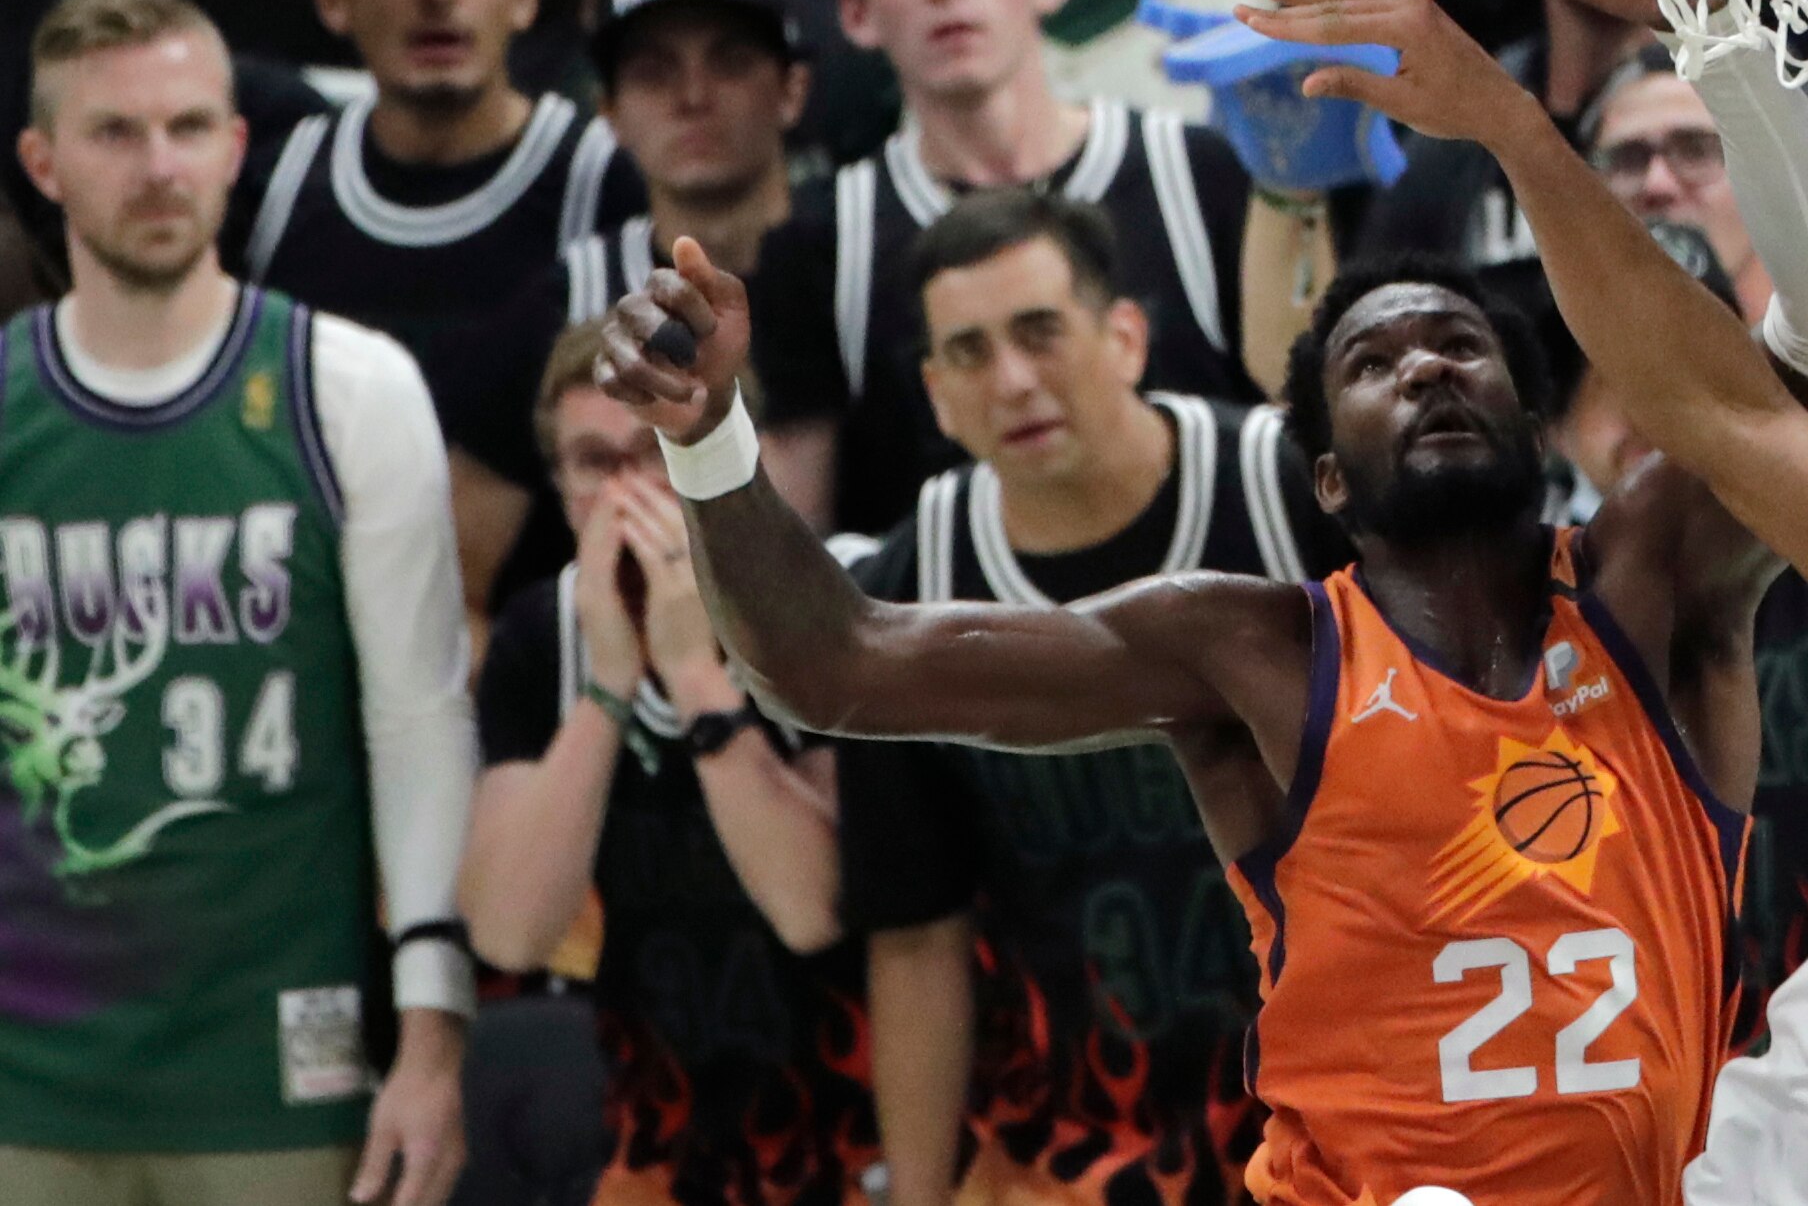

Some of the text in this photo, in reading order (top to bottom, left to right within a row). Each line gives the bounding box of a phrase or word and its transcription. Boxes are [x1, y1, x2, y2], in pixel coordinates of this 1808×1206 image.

[0, 502, 297, 645] BUCKS
[160, 668, 300, 797] 34
[1549, 675, 1609, 716] ayPal
[1432, 926, 1641, 1103] 22
